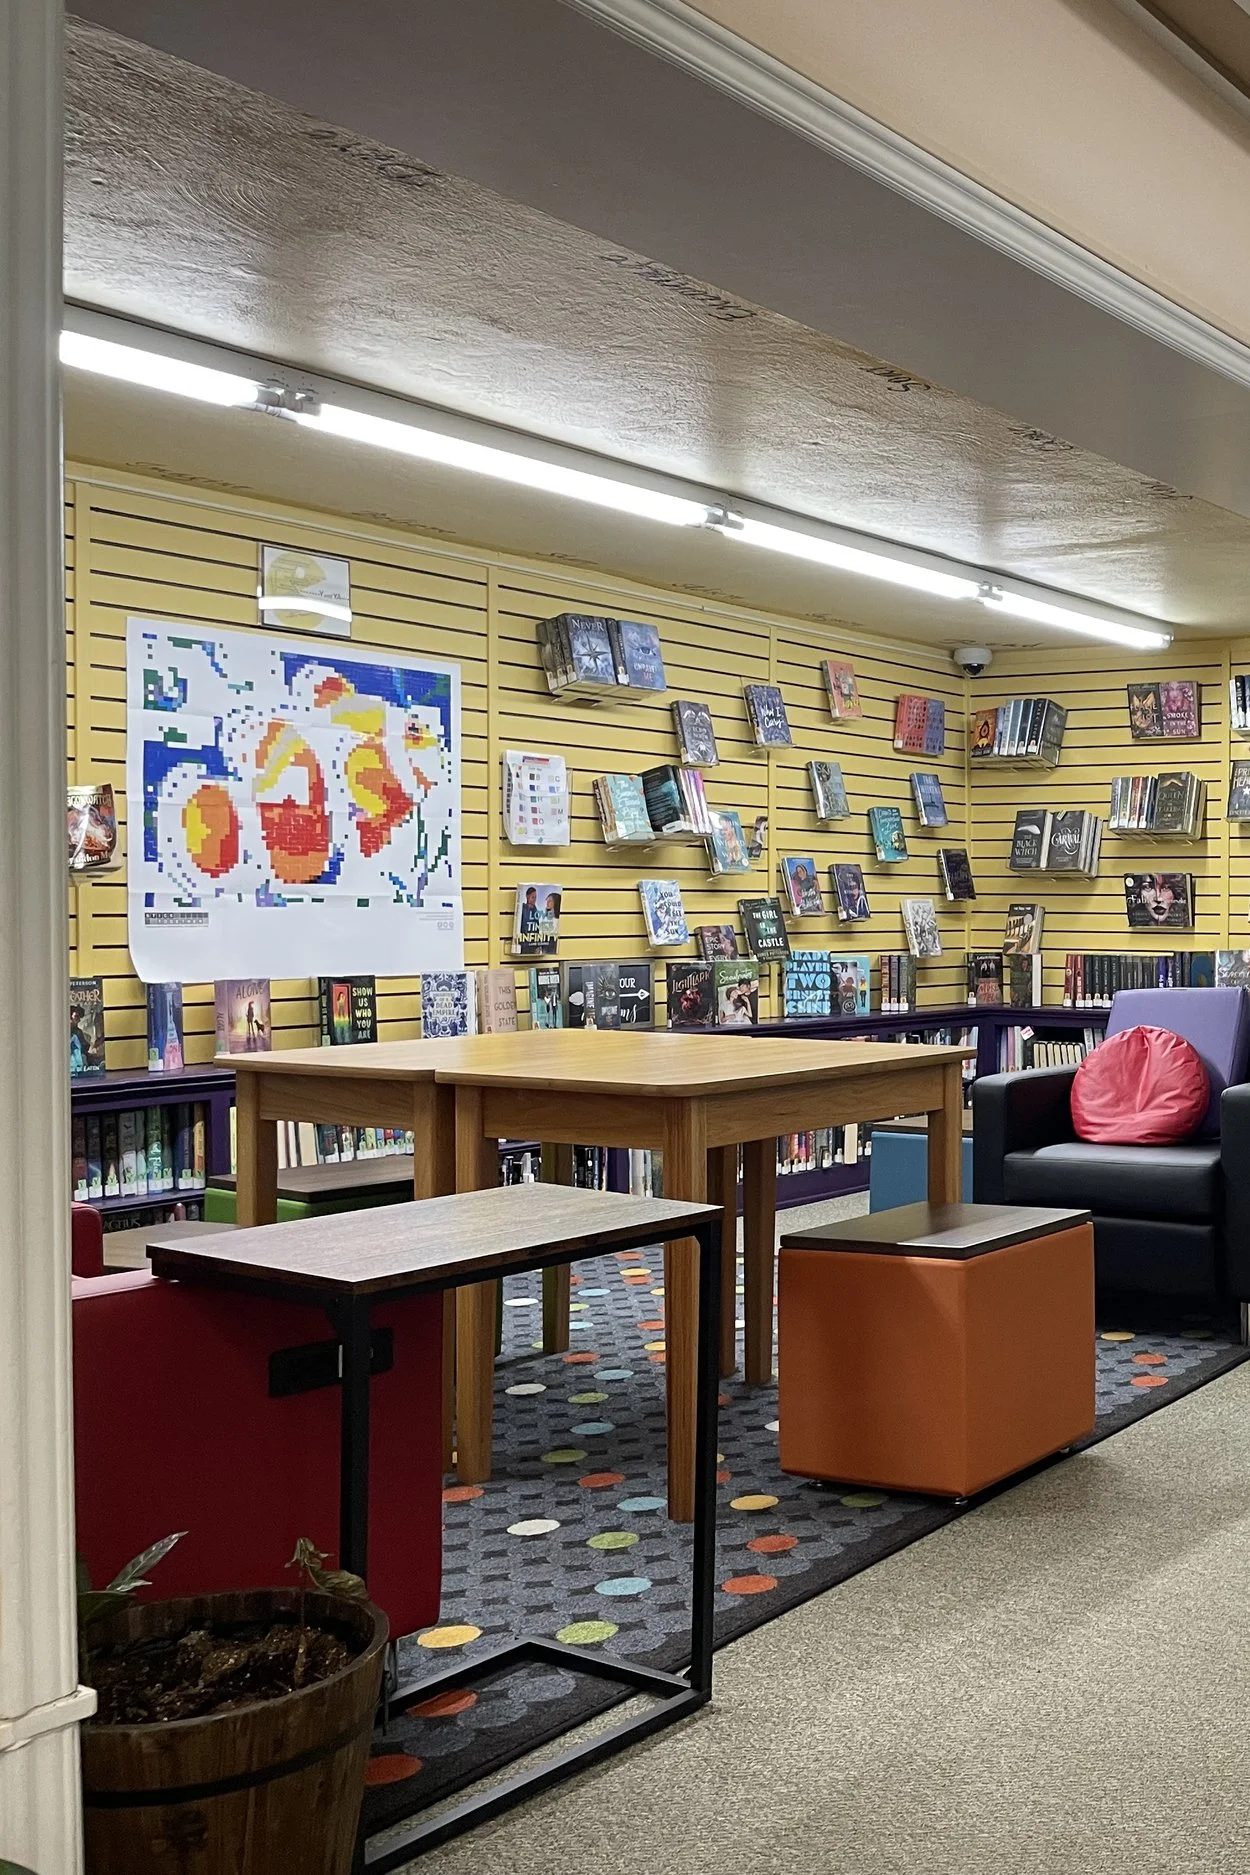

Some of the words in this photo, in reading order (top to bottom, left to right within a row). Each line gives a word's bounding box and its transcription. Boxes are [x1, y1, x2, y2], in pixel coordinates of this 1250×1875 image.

[572, 618, 605, 632] NEVER
[529, 910, 554, 920] LOVE
[761, 910, 778, 919] GIRL
[758, 938, 784, 948] CASTLE
[786, 961, 830, 973] PLAYER
[672, 971, 712, 993] LIGHTLARK
[788, 974, 831, 989] TWO
[352, 986, 373, 997] SHOW
[358, 998, 368, 1007] US
[355, 1009, 372, 1018] WHO
[356, 1019, 371, 1029] YOU
[498, 1018, 516, 1027] STATE
[357, 1029, 371, 1039] ARE
